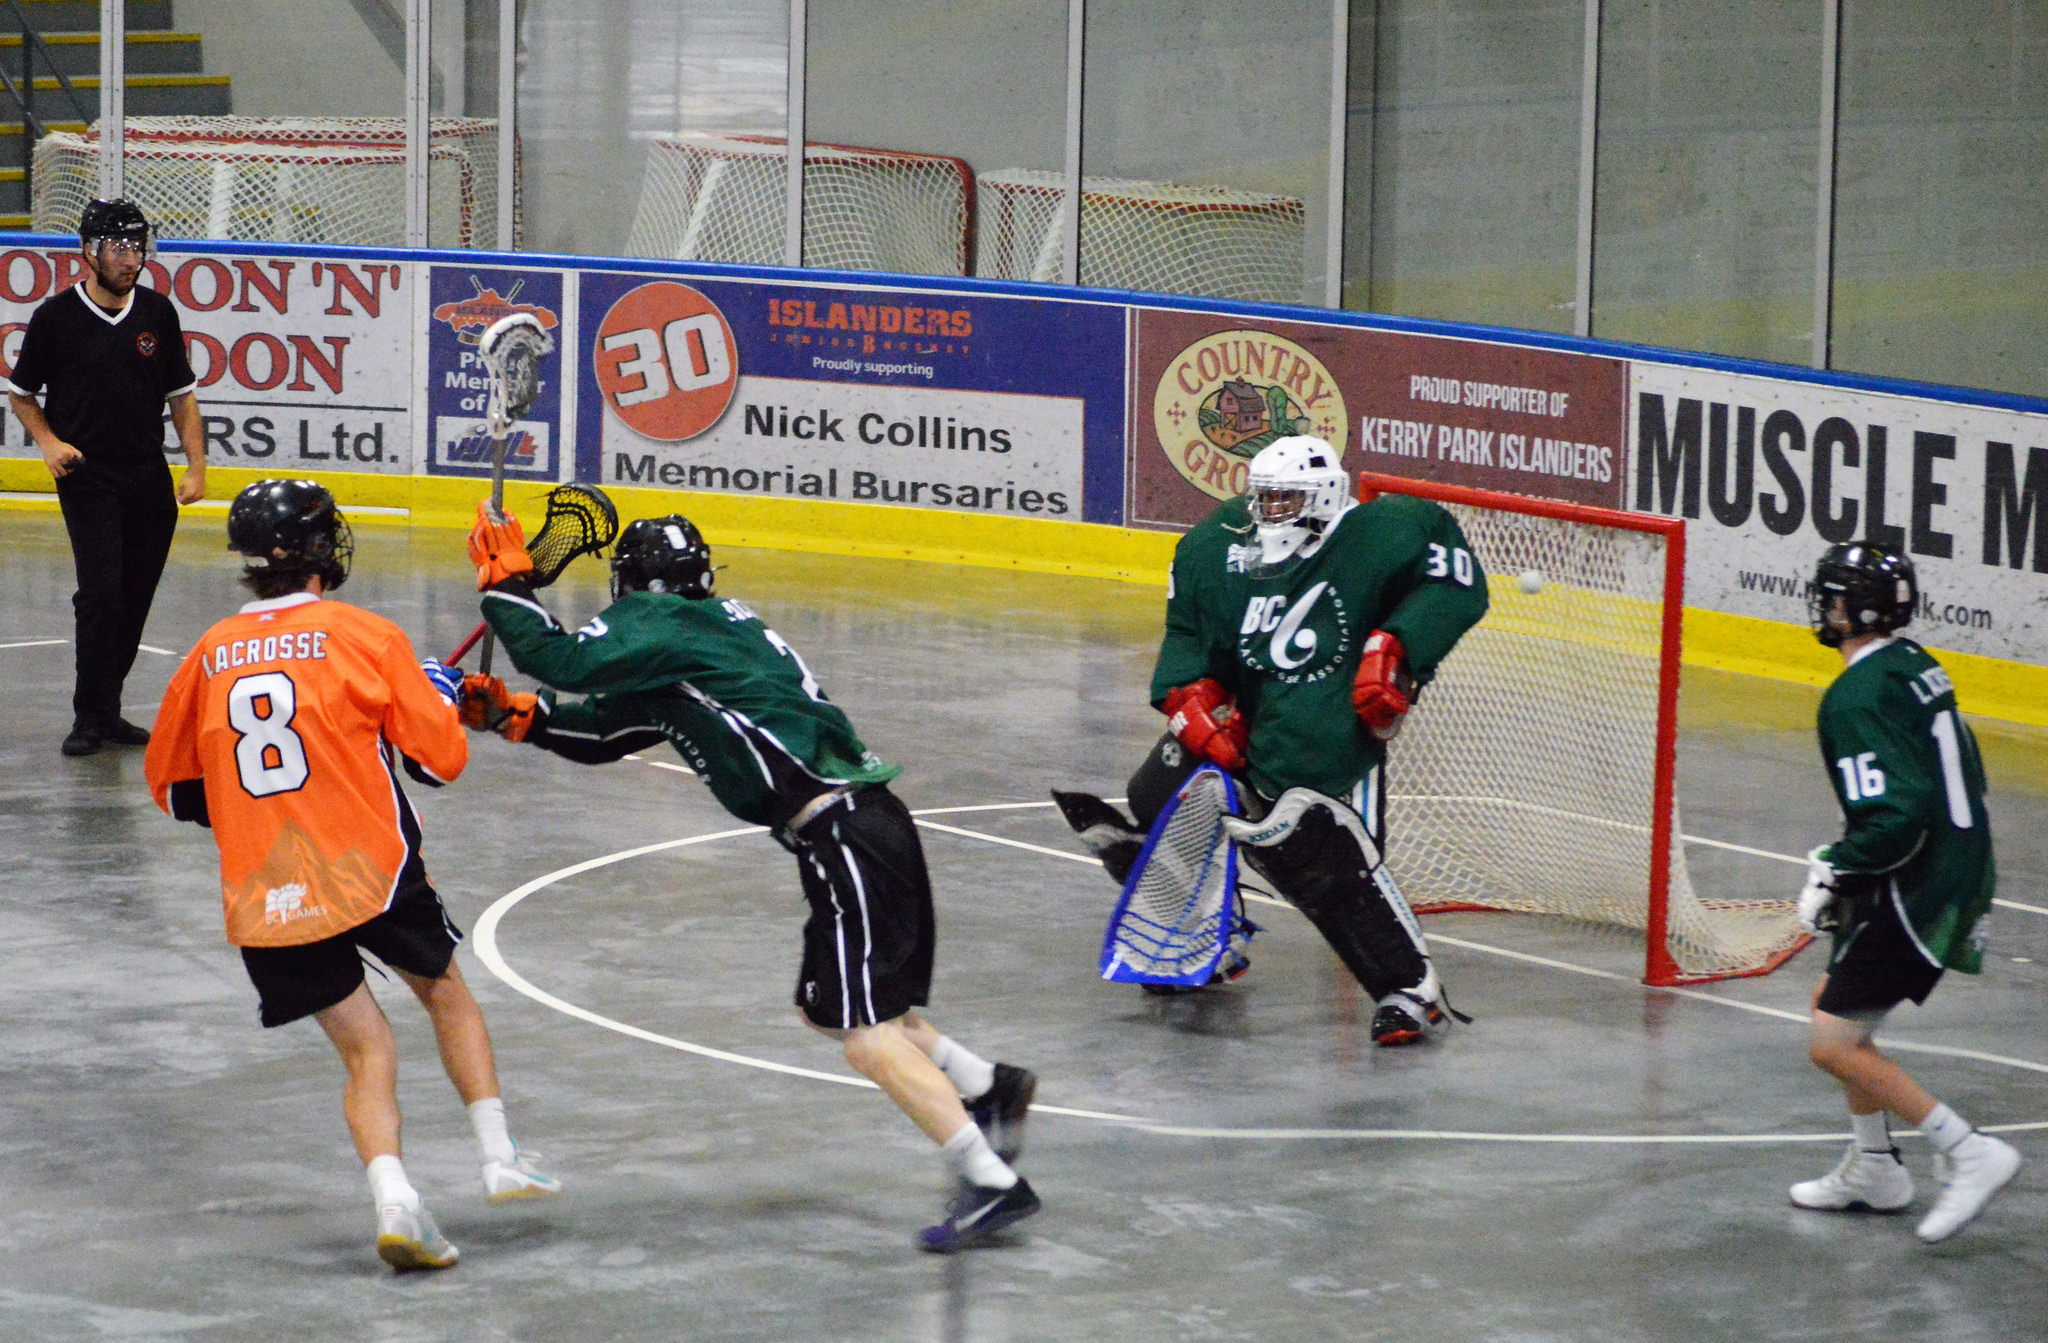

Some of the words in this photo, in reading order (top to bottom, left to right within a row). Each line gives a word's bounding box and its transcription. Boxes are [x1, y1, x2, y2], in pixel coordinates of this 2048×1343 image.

[768, 298, 973, 337] ISLANDERS
[602, 312, 730, 408] 30
[812, 356, 862, 375] Proudly
[863, 362, 934, 379] supporting
[1177, 340, 1333, 409] COUNTRY
[459, 393, 488, 412] of
[1410, 374, 1461, 405] PROUD
[1463, 380, 1547, 416] SUPPORTER
[1550, 391, 1569, 418] OF
[299, 419, 399, 463] Ltd.
[743, 404, 845, 444] Nick
[858, 411, 1013, 454] Collins
[1361, 416, 1433, 459] KERRY
[1437, 425, 1495, 467] PARK
[1499, 432, 1613, 484] ISLANDERS
[614, 452, 838, 498] Memorial
[852, 470, 1069, 516] Bursaries
[1635, 391, 1957, 559] MUSCLE
[1425, 542, 1474, 589] 30
[1240, 594, 1288, 634] BC
[202, 631, 329, 680] LACROSSE
[228, 670, 311, 799] 8
[1836, 751, 1886, 802] 16
